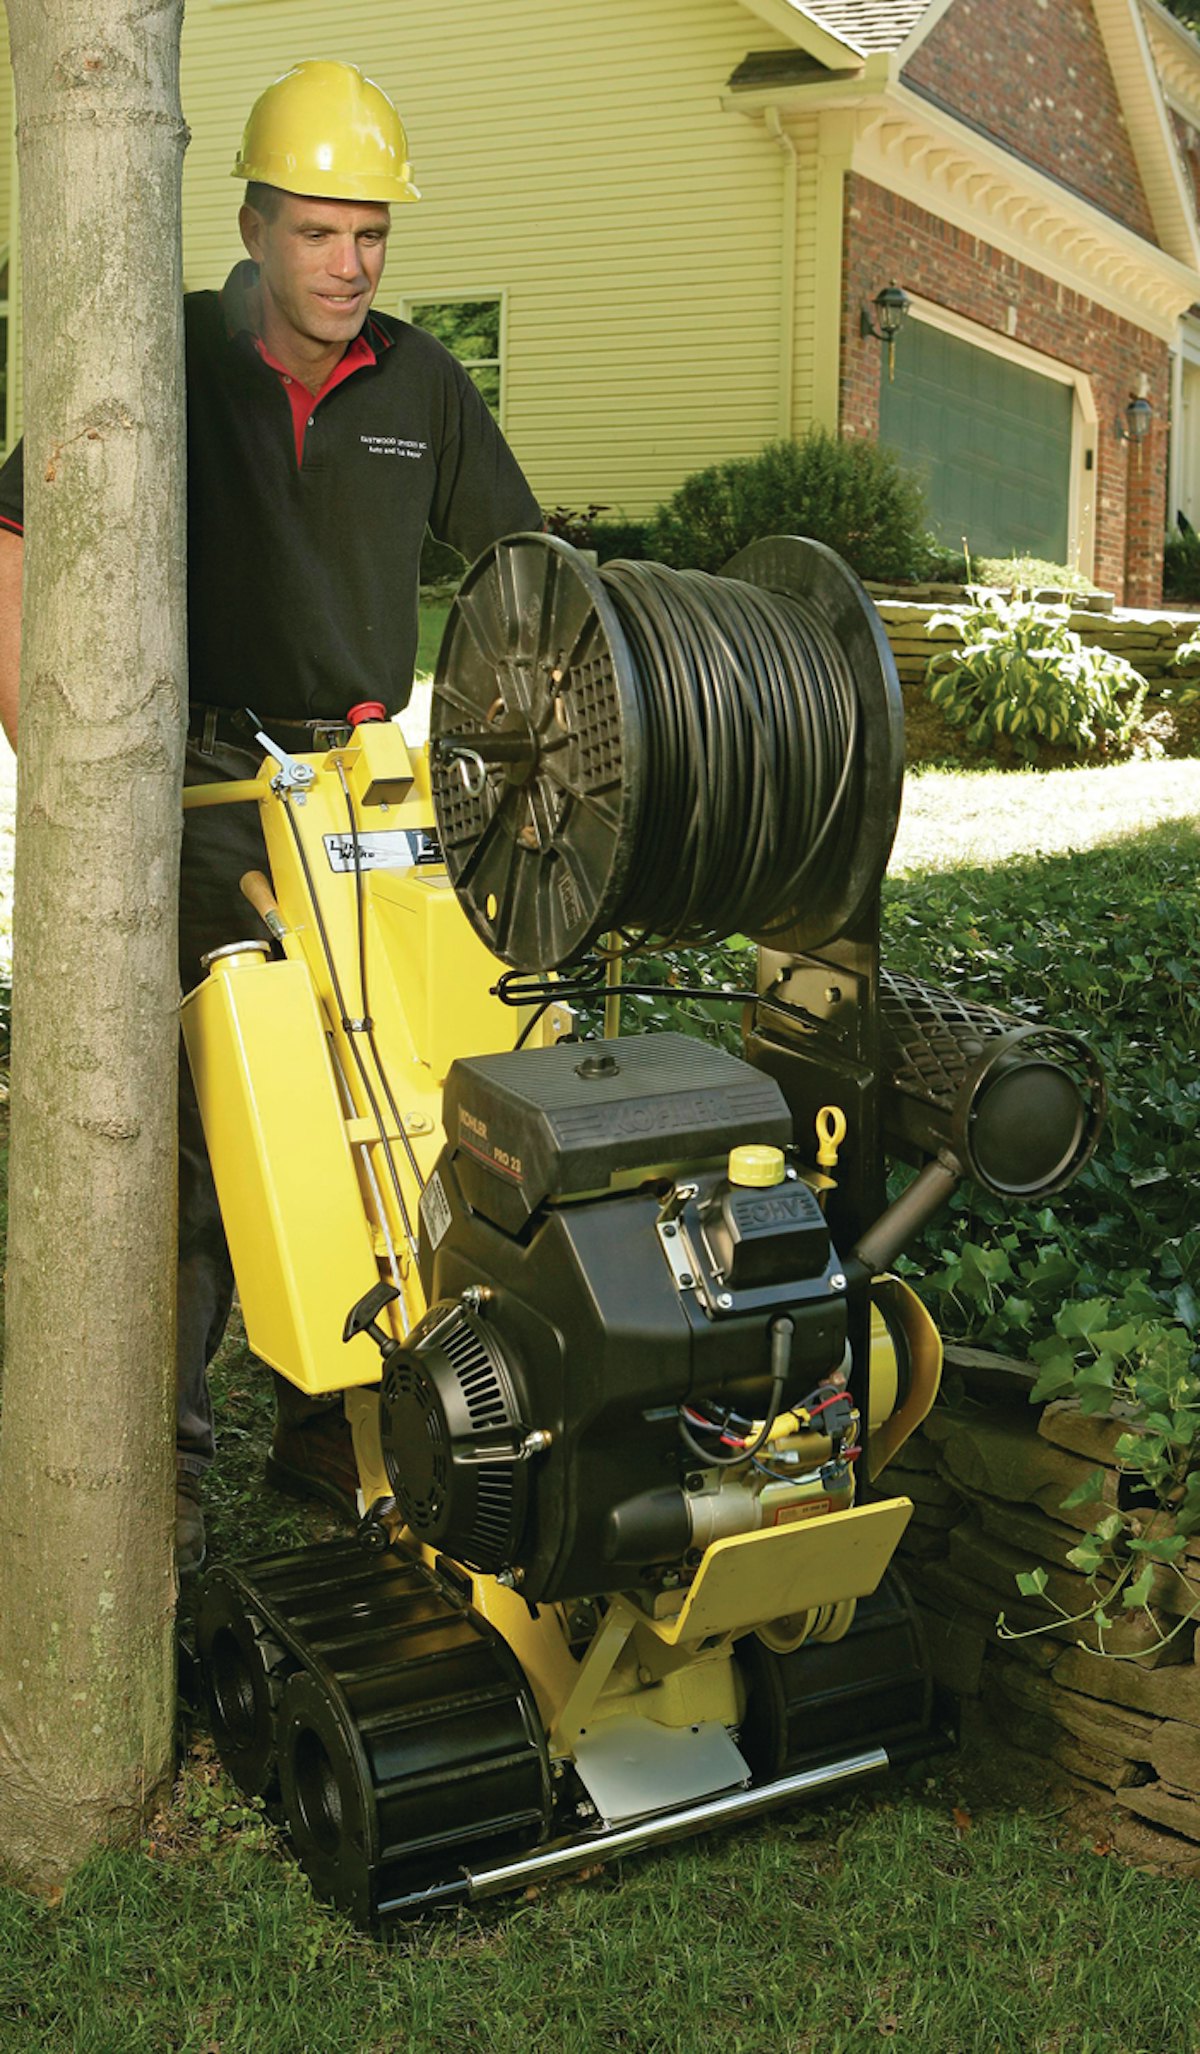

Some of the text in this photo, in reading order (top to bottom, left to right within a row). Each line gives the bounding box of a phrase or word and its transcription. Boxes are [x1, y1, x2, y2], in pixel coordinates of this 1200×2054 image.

[458, 1103, 488, 1140] KOHLER
[601, 1096, 731, 1136] KOHLER
[494, 1146, 522, 1174] PRO 23
[750, 1197, 800, 1222] OHV
